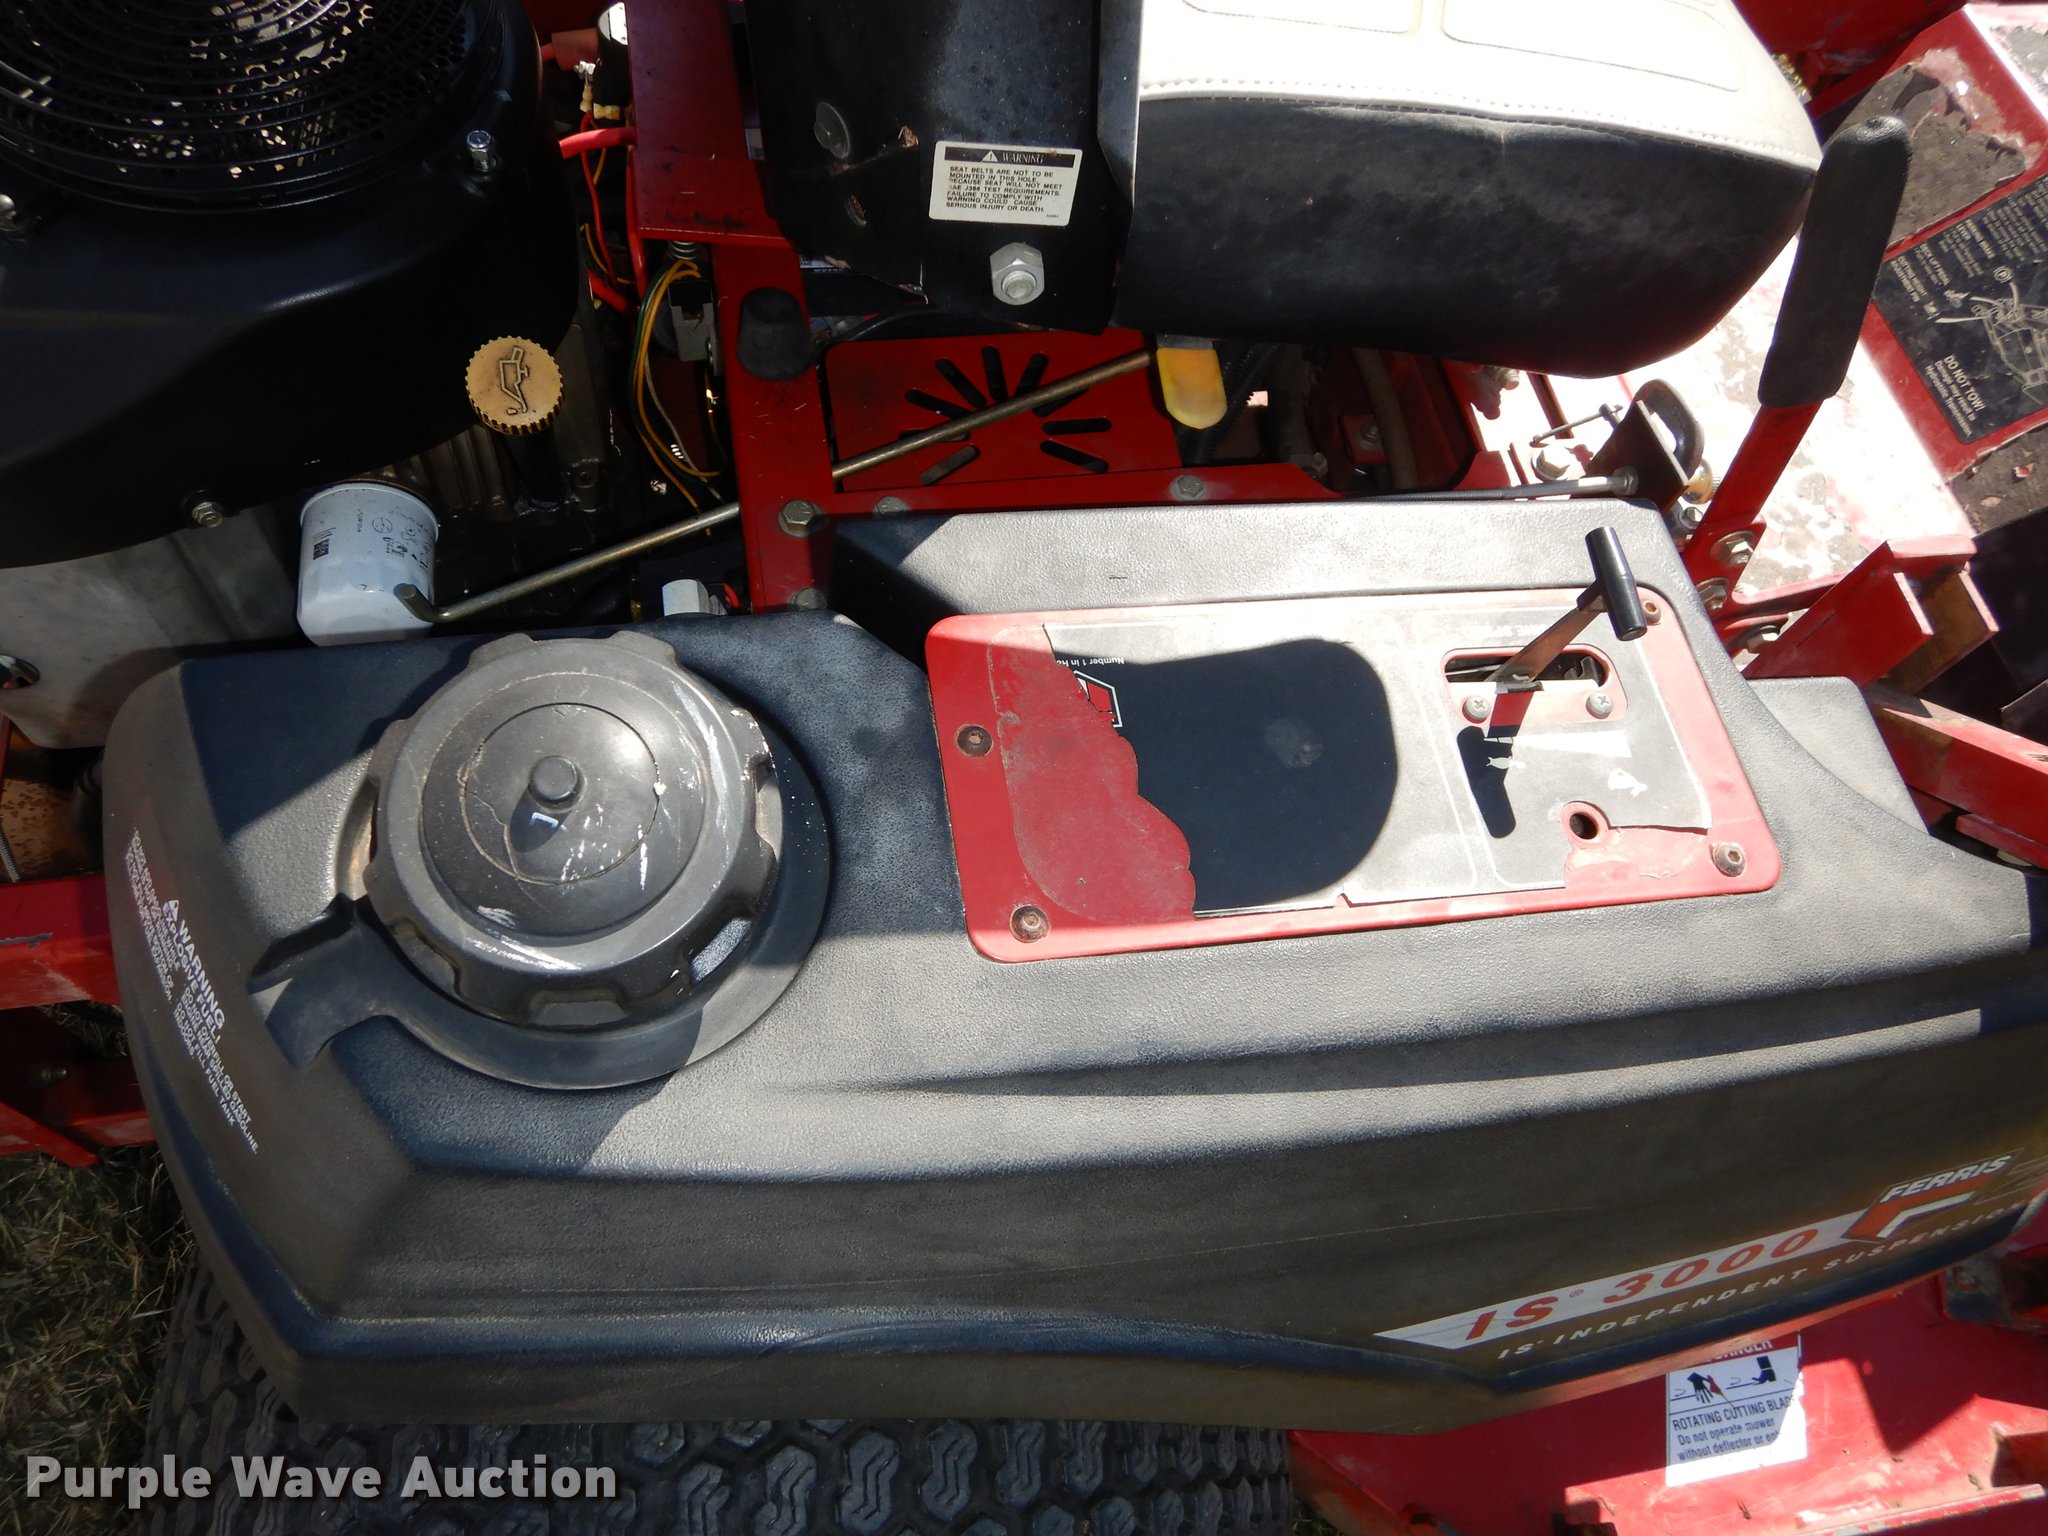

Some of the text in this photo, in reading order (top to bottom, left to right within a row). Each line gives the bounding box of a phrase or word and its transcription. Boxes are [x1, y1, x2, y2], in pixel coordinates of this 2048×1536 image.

[1002, 152, 1043, 164] WARNING
[1004, 188, 1060, 196] REQUIREMENTS.
[1943, 354, 1986, 412] DO NOT TOW!
[1089, 656, 1124, 665] Number
[162, 902, 221, 1044] EXPLOSIVE FUEL!
[179, 920, 225, 1029] WARNING
[184, 986, 252, 1124] DO NOT OVERFILL OR START
[195, 1042, 206, 1069] FILL
[205, 1067, 220, 1097] FUEL
[219, 1096, 236, 1127] TANK
[209, 1058, 231, 1100] SPILLED
[229, 1101, 259, 1154] GASOLINE.
[1879, 1155, 2011, 1203] FERRIS
[1602, 1228, 1818, 1304] 3000
[1553, 1267, 1808, 1345] INDEPENDENT
[1672, 1411, 1722, 1431] ROTATING
[1724, 1400, 1765, 1421] CUTTING
[1677, 1435, 1690, 1446] Do
[1693, 1432, 1708, 1443] not
[1709, 1426, 1743, 1443] operate
[1677, 1444, 1712, 1461] without
[1713, 1437, 1752, 1454] deflector
[1754, 1436, 1764, 1445] or
